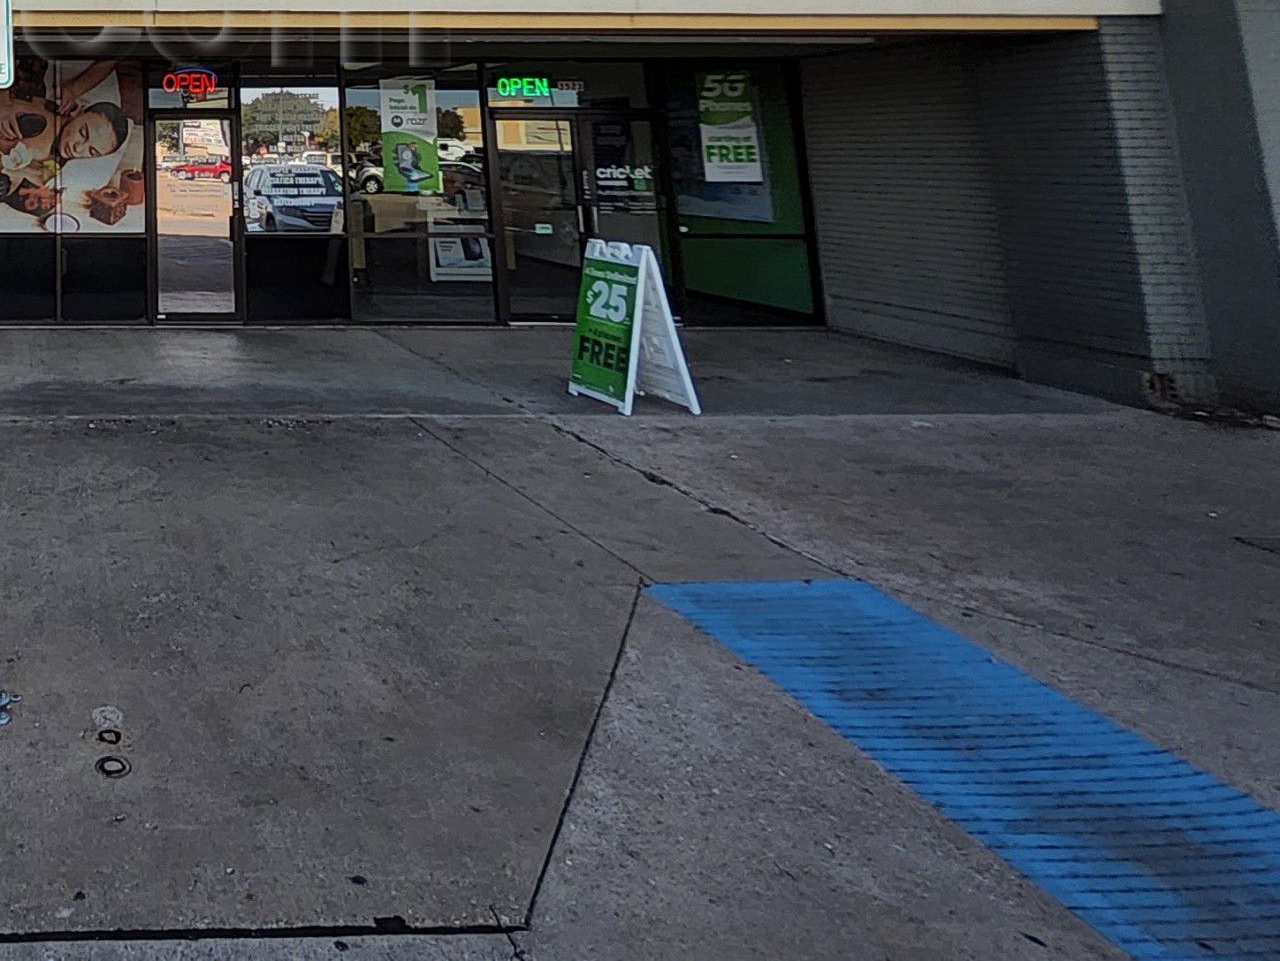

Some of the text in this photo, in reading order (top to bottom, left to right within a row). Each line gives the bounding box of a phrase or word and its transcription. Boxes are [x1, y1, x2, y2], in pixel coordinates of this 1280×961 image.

[162, 73, 216, 93] OPEN
[497, 78, 550, 96] OPEN
[700, 74, 745, 97] 5G
[705, 144, 758, 163] FREE
[596, 164, 654, 179] cricket
[586, 280, 628, 322] $25
[577, 334, 627, 373] FREE
